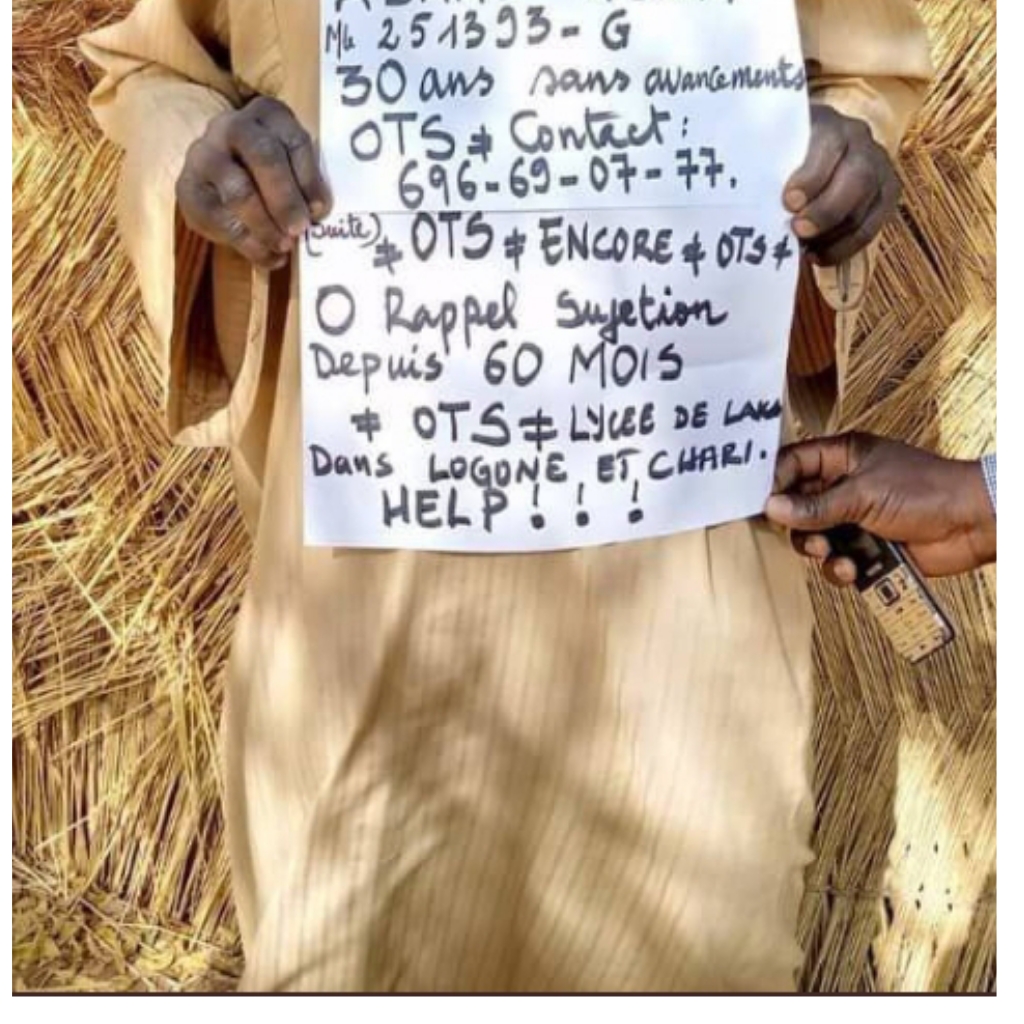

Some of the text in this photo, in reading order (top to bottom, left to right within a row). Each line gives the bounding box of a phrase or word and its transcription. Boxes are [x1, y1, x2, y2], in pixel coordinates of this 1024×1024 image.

[337, 58, 807, 107] 30 ans sans avancements
[349, 111, 456, 165] OTS
[410, 211, 495, 263] OTS
[538, 216, 674, 267] ENCORE
[715, 225, 768, 270] OTS
[384, 280, 521, 355] Rappel
[311, 337, 684, 395] Depuis 60 MOIS
[412, 400, 512, 448] OTS
[569, 402, 655, 443] LYCEE
[673, 400, 709, 431] DE
[309, 444, 394, 479] Dans
[428, 449, 569, 489] LOGONE
[596, 447, 640, 485] ET
